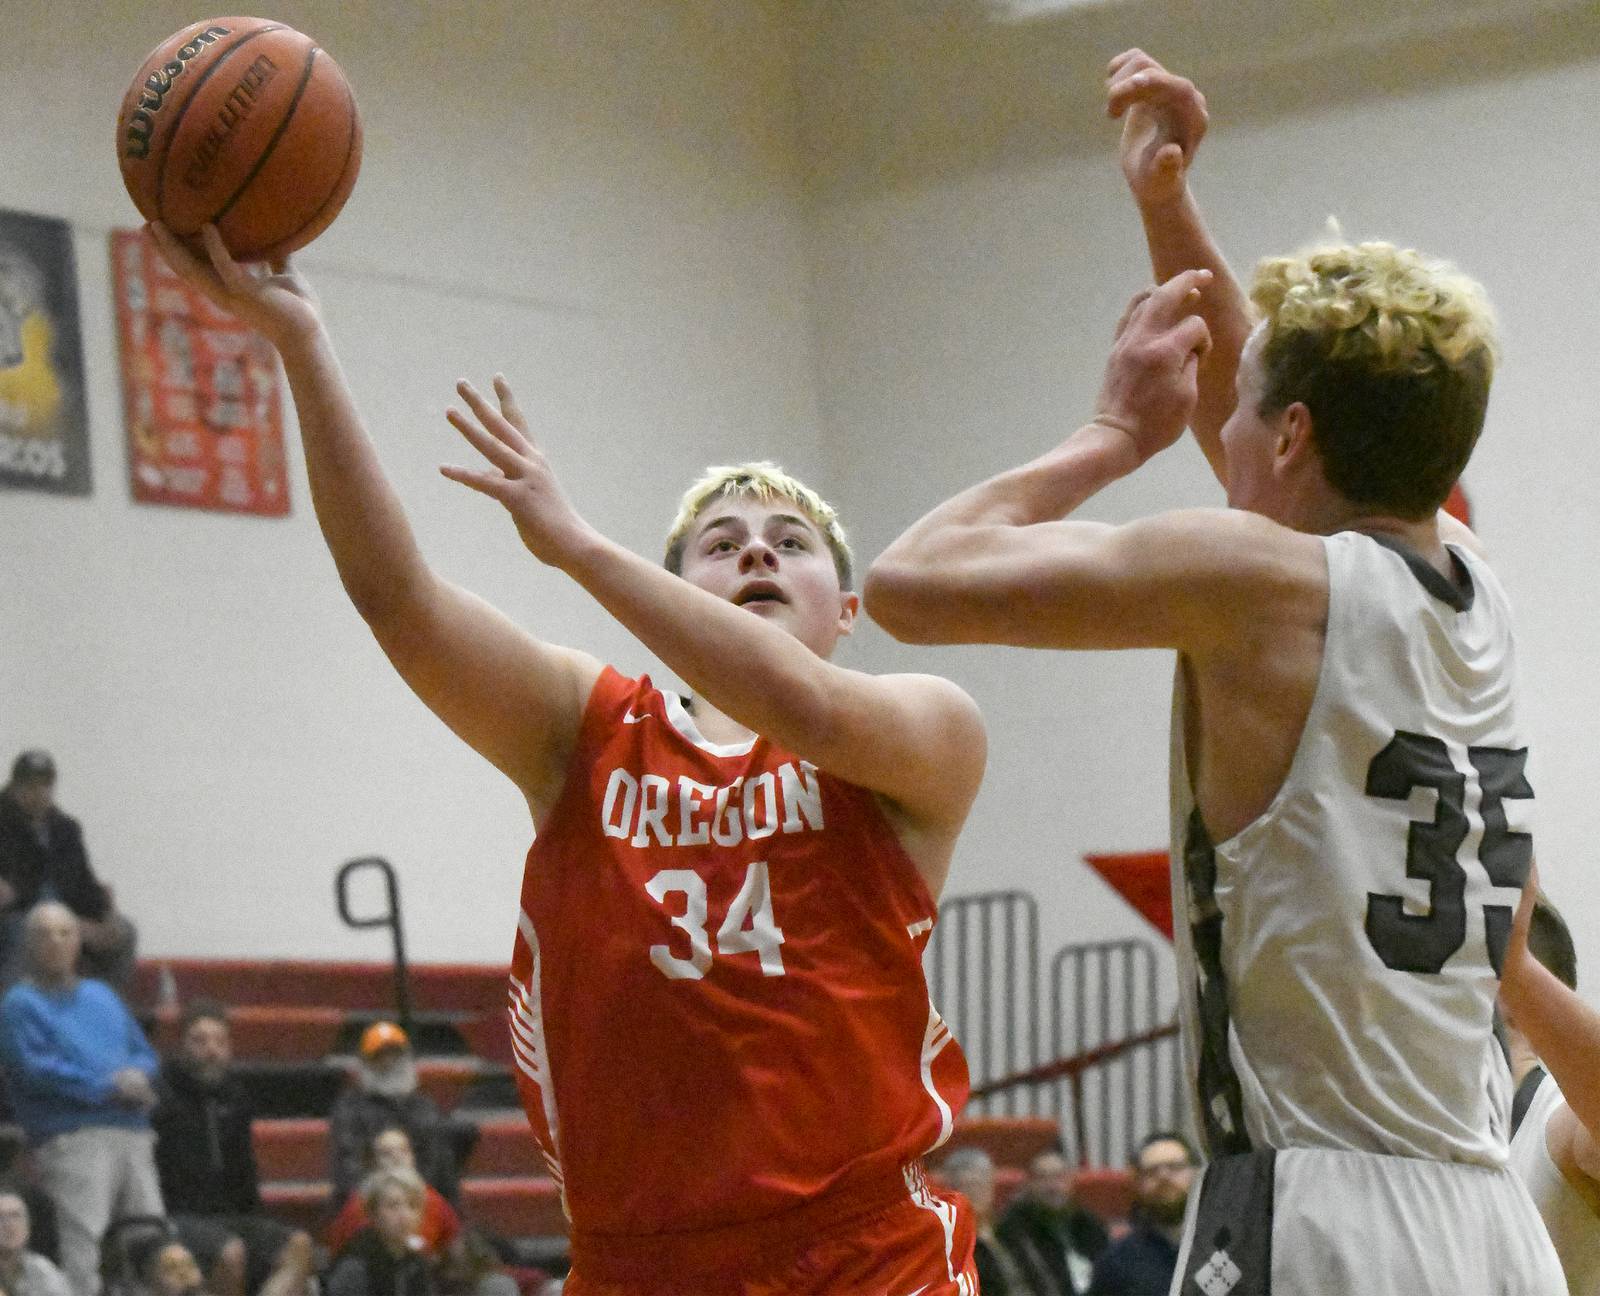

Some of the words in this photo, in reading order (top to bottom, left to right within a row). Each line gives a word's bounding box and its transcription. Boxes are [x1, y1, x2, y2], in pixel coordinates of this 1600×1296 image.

[126, 26, 232, 158] Wilson
[602, 760, 825, 848] OREGON
[1365, 729, 1535, 980] 35
[644, 861, 786, 980] 34
